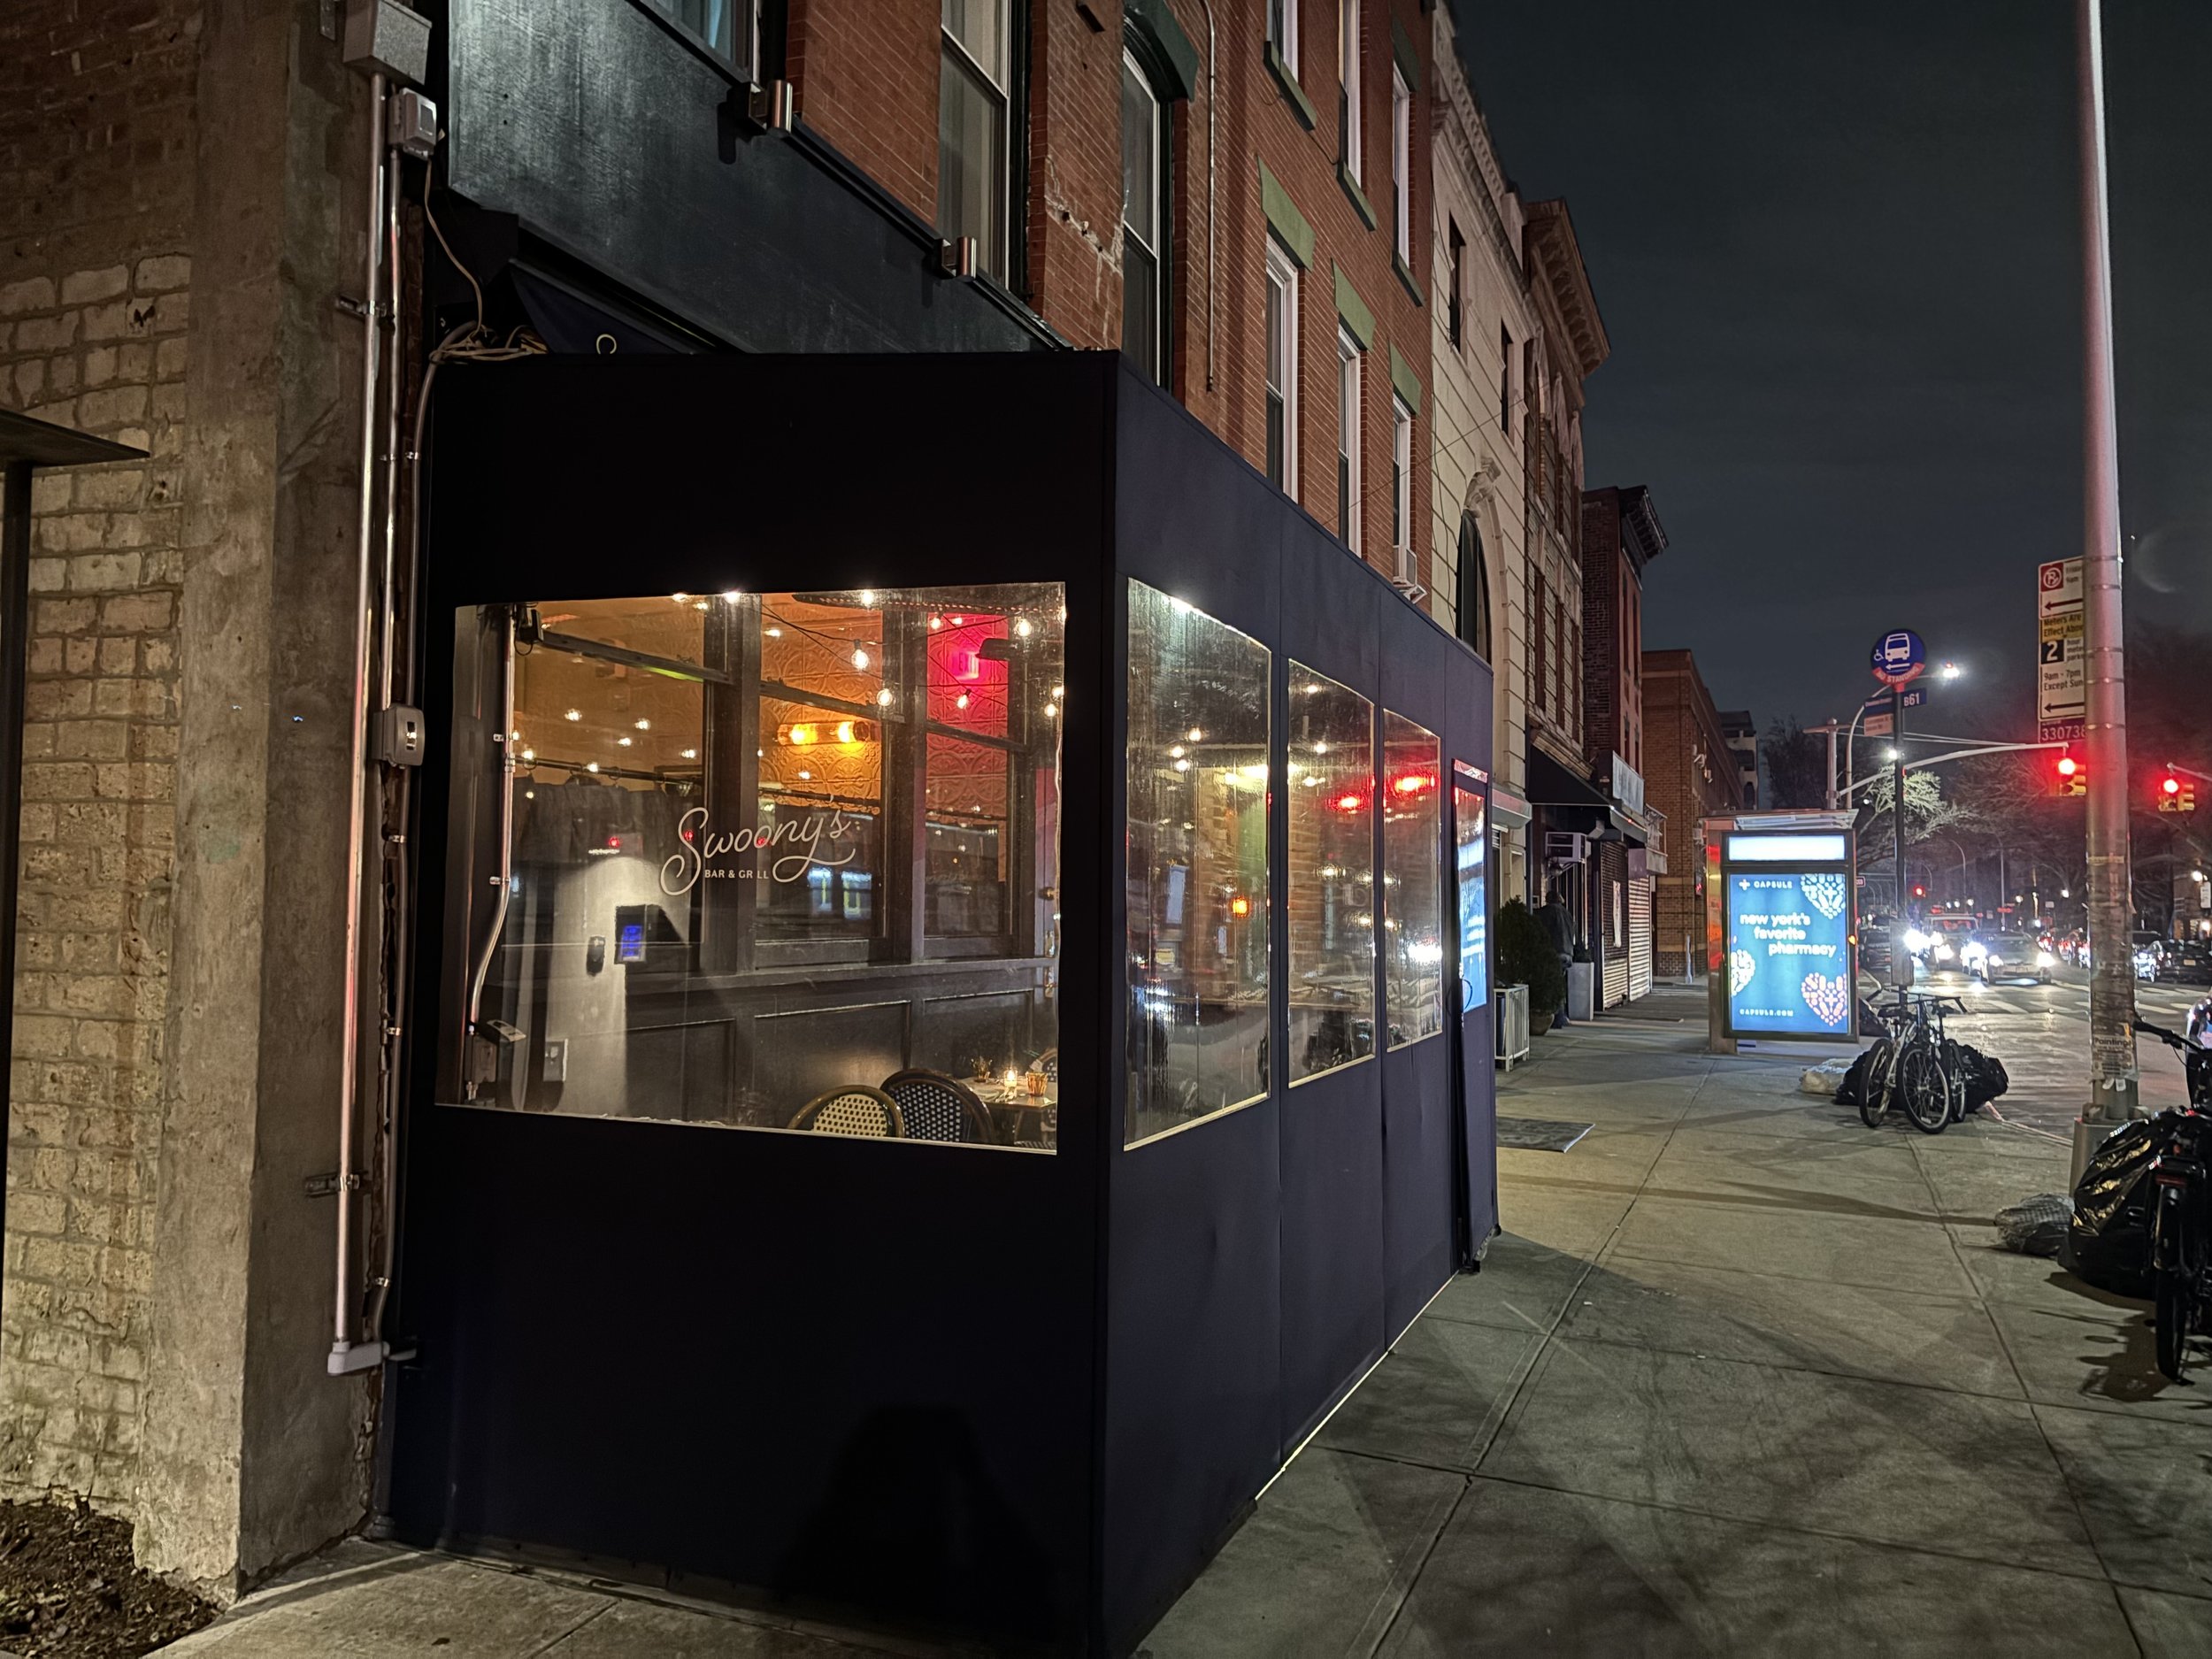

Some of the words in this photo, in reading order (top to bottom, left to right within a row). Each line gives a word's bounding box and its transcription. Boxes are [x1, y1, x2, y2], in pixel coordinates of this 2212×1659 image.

[2047, 641, 2058, 661] 2
[2066, 669, 2081, 678] 7pm
[2044, 680, 2068, 691] Except
[2070, 679, 2084, 687] Sun
[1903, 693, 1920, 707] B61
[660, 795, 856, 896] Swoony's
[704, 870, 726, 879] BAR
[728, 870, 735, 879] &
[738, 870, 769, 879] GRLL
[1754, 880, 1793, 889] CAPSULE
[1740, 914, 1769, 925] new
[1770, 912, 1811, 927] york's
[1754, 926, 1806, 941] favorite
[1768, 941, 1837, 958] pharmacy
